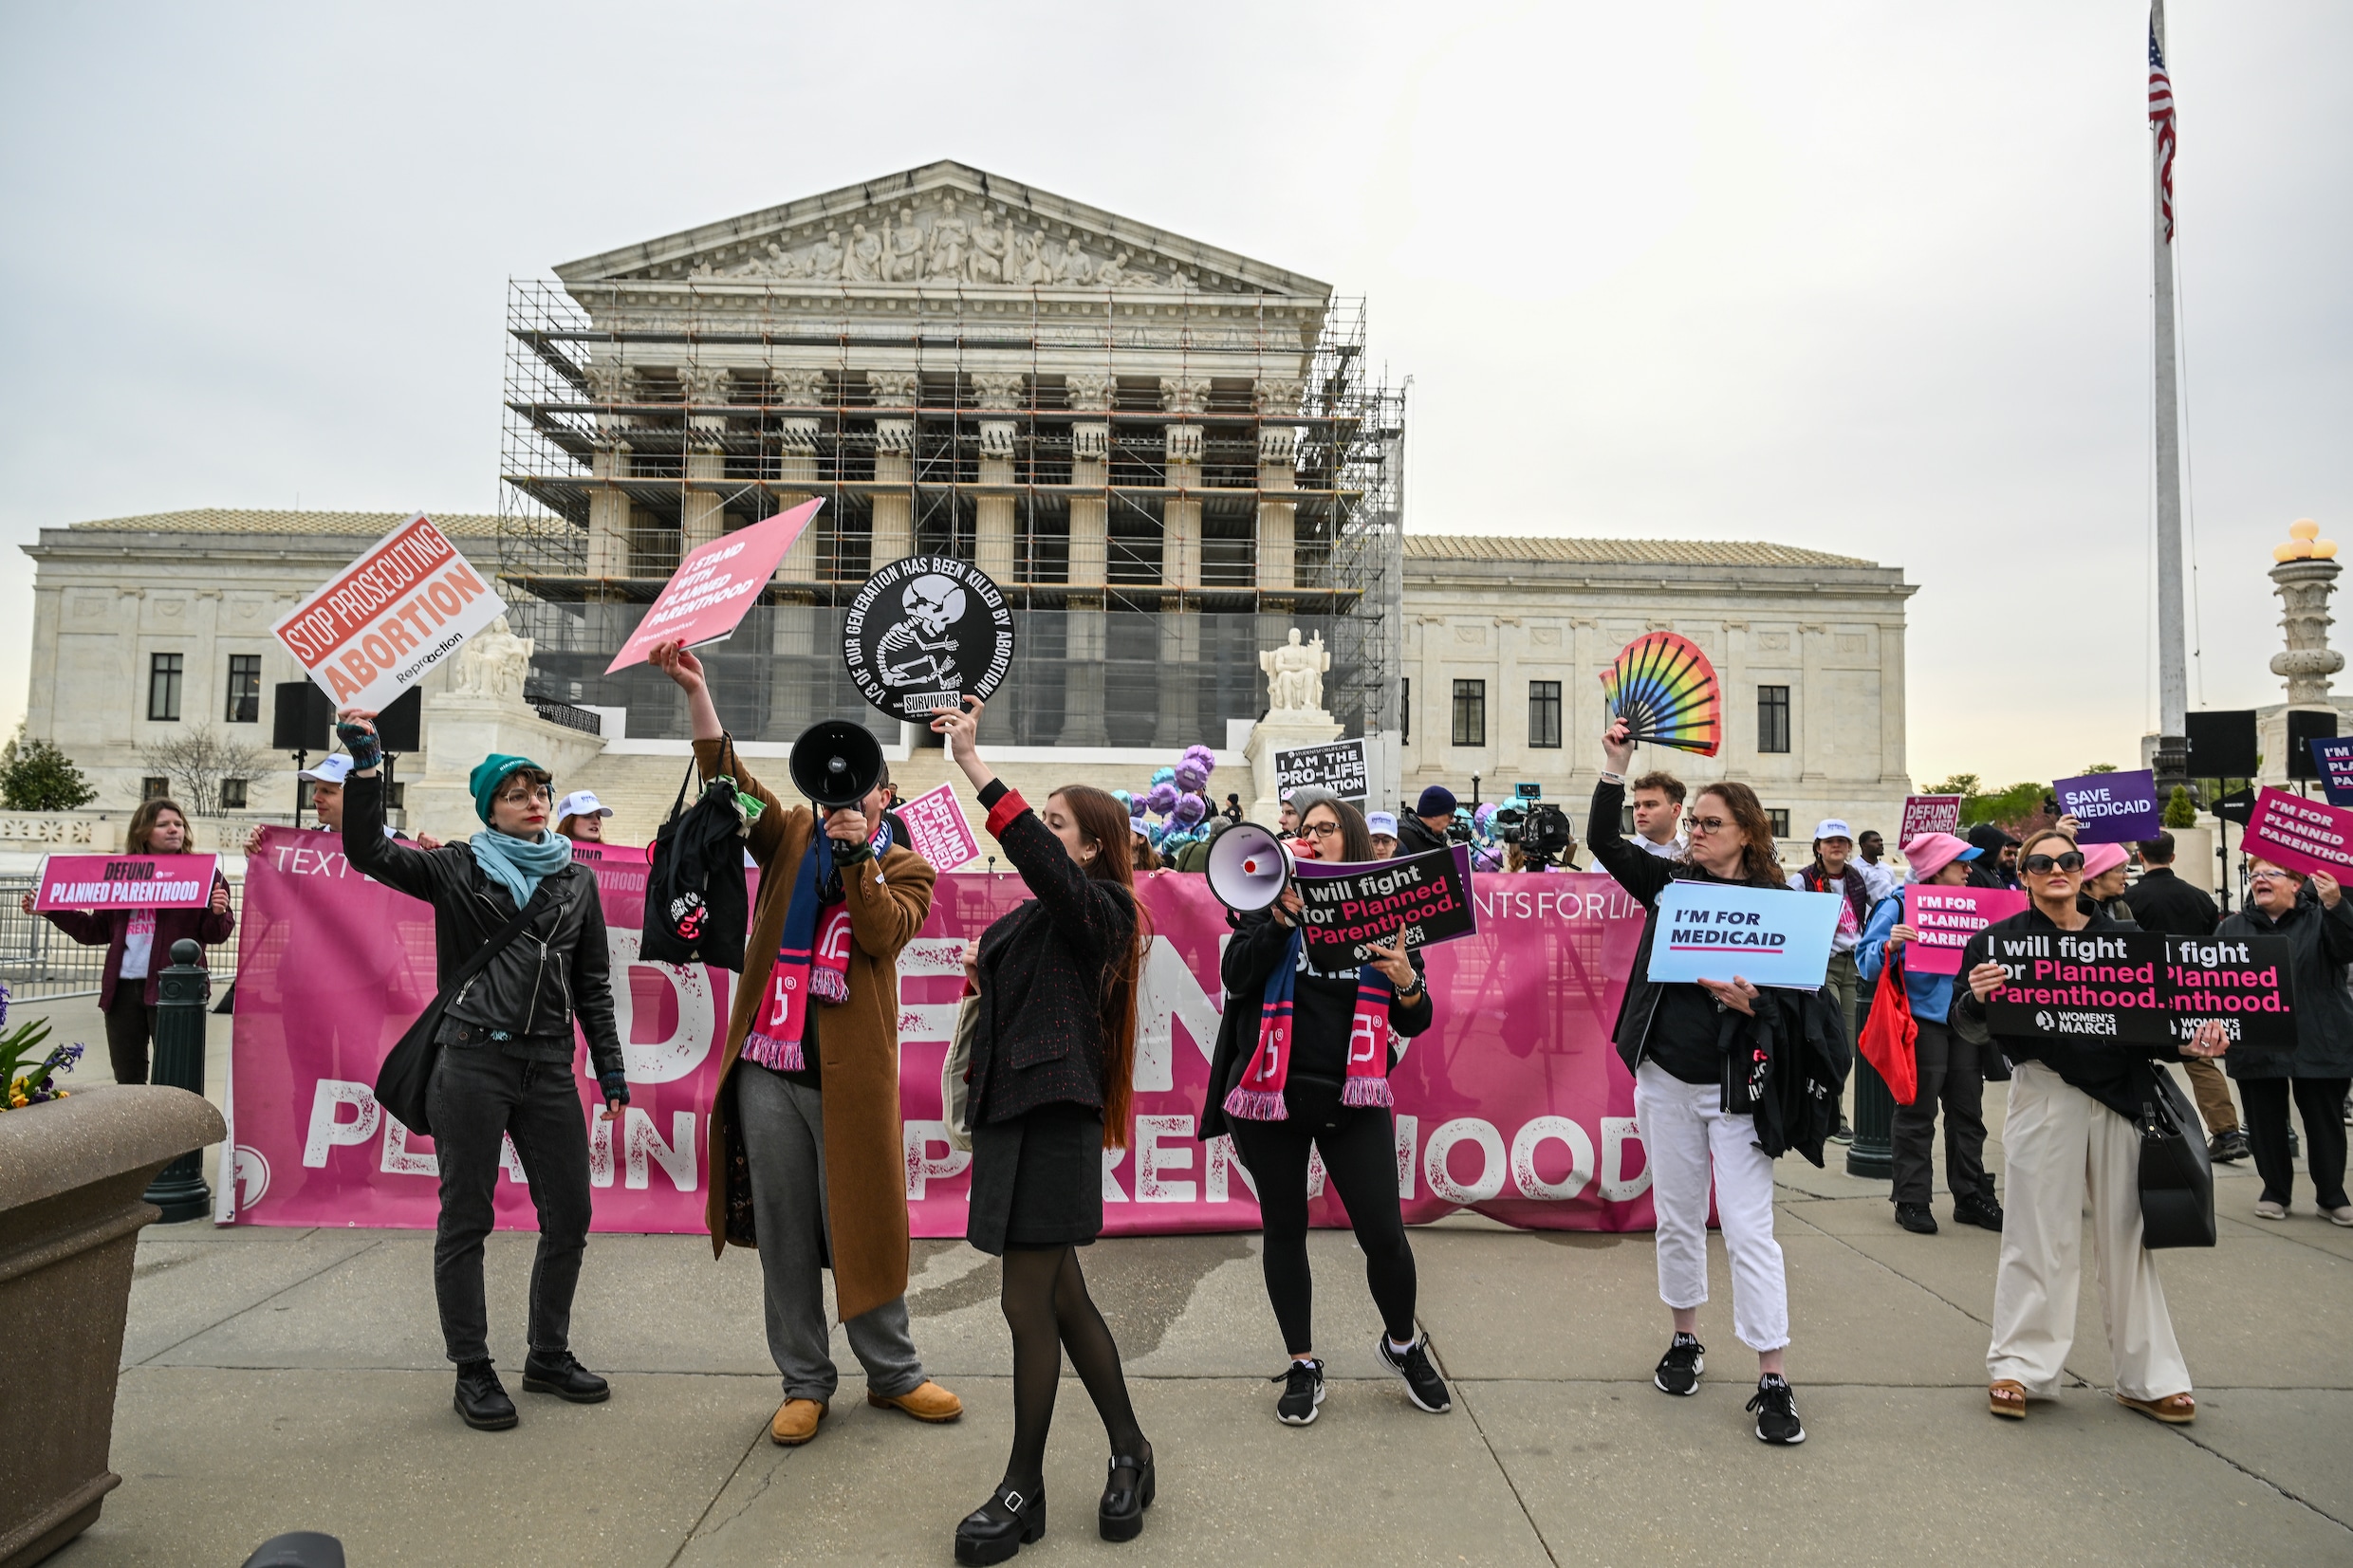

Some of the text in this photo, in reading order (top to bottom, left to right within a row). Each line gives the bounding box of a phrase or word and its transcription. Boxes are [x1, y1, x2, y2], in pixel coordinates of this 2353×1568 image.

[684, 542, 746, 575] I STAND
[674, 566, 716, 591] WITH
[286, 524, 450, 661] STOP PROSECUTING
[659, 573, 732, 610] PLANNED
[324, 562, 486, 705] ABORTION
[844, 557, 1012, 705] 1/3 OF OUR GENERATION HAS BEEN KILLED BY ABORTION!
[906, 692, 958, 711] SURVIVORS
[1280, 749, 1358, 770] I AM THE
[2324, 746, 2350, 758] I'M
[1277, 761, 1364, 786] PRO-LIFE
[2065, 788, 2111, 805] SAVE
[1906, 804, 1956, 820] DEFUND
[2069, 799, 2151, 819] MEDICAID
[2270, 799, 2334, 827] I'M FOR
[915, 801, 953, 870] PLANNED
[927, 792, 969, 862] DEFUND
[1904, 820, 1955, 833] PLANNED
[2264, 813, 2344, 845] PLANNED
[103, 861, 156, 881] DEFUND
[275, 845, 348, 879] TEXT
[49, 881, 200, 903] PLANNED PARENTHOOD
[1295, 864, 1422, 902] I will fight
[1301, 876, 1449, 924] for Planned
[1918, 895, 1976, 911] I'M FOR
[1306, 895, 1461, 945] Parenthood.
[1675, 910, 1760, 926] I'M FOR
[1918, 913, 1990, 931] PLANNED
[1373, 925, 1423, 946] WOMN'S
[1671, 929, 1787, 947] MEDICAID
[1988, 935, 2128, 963] I will fight
[2178, 941, 2251, 968] fight
[2034, 960, 2154, 984] Planned
[1990, 984, 2165, 1008] Parenthood.
[2169, 990, 2290, 1012] nthood.
[2058, 1011, 2117, 1024] WOMEN'S
[2058, 1020, 2118, 1036] MARCH
